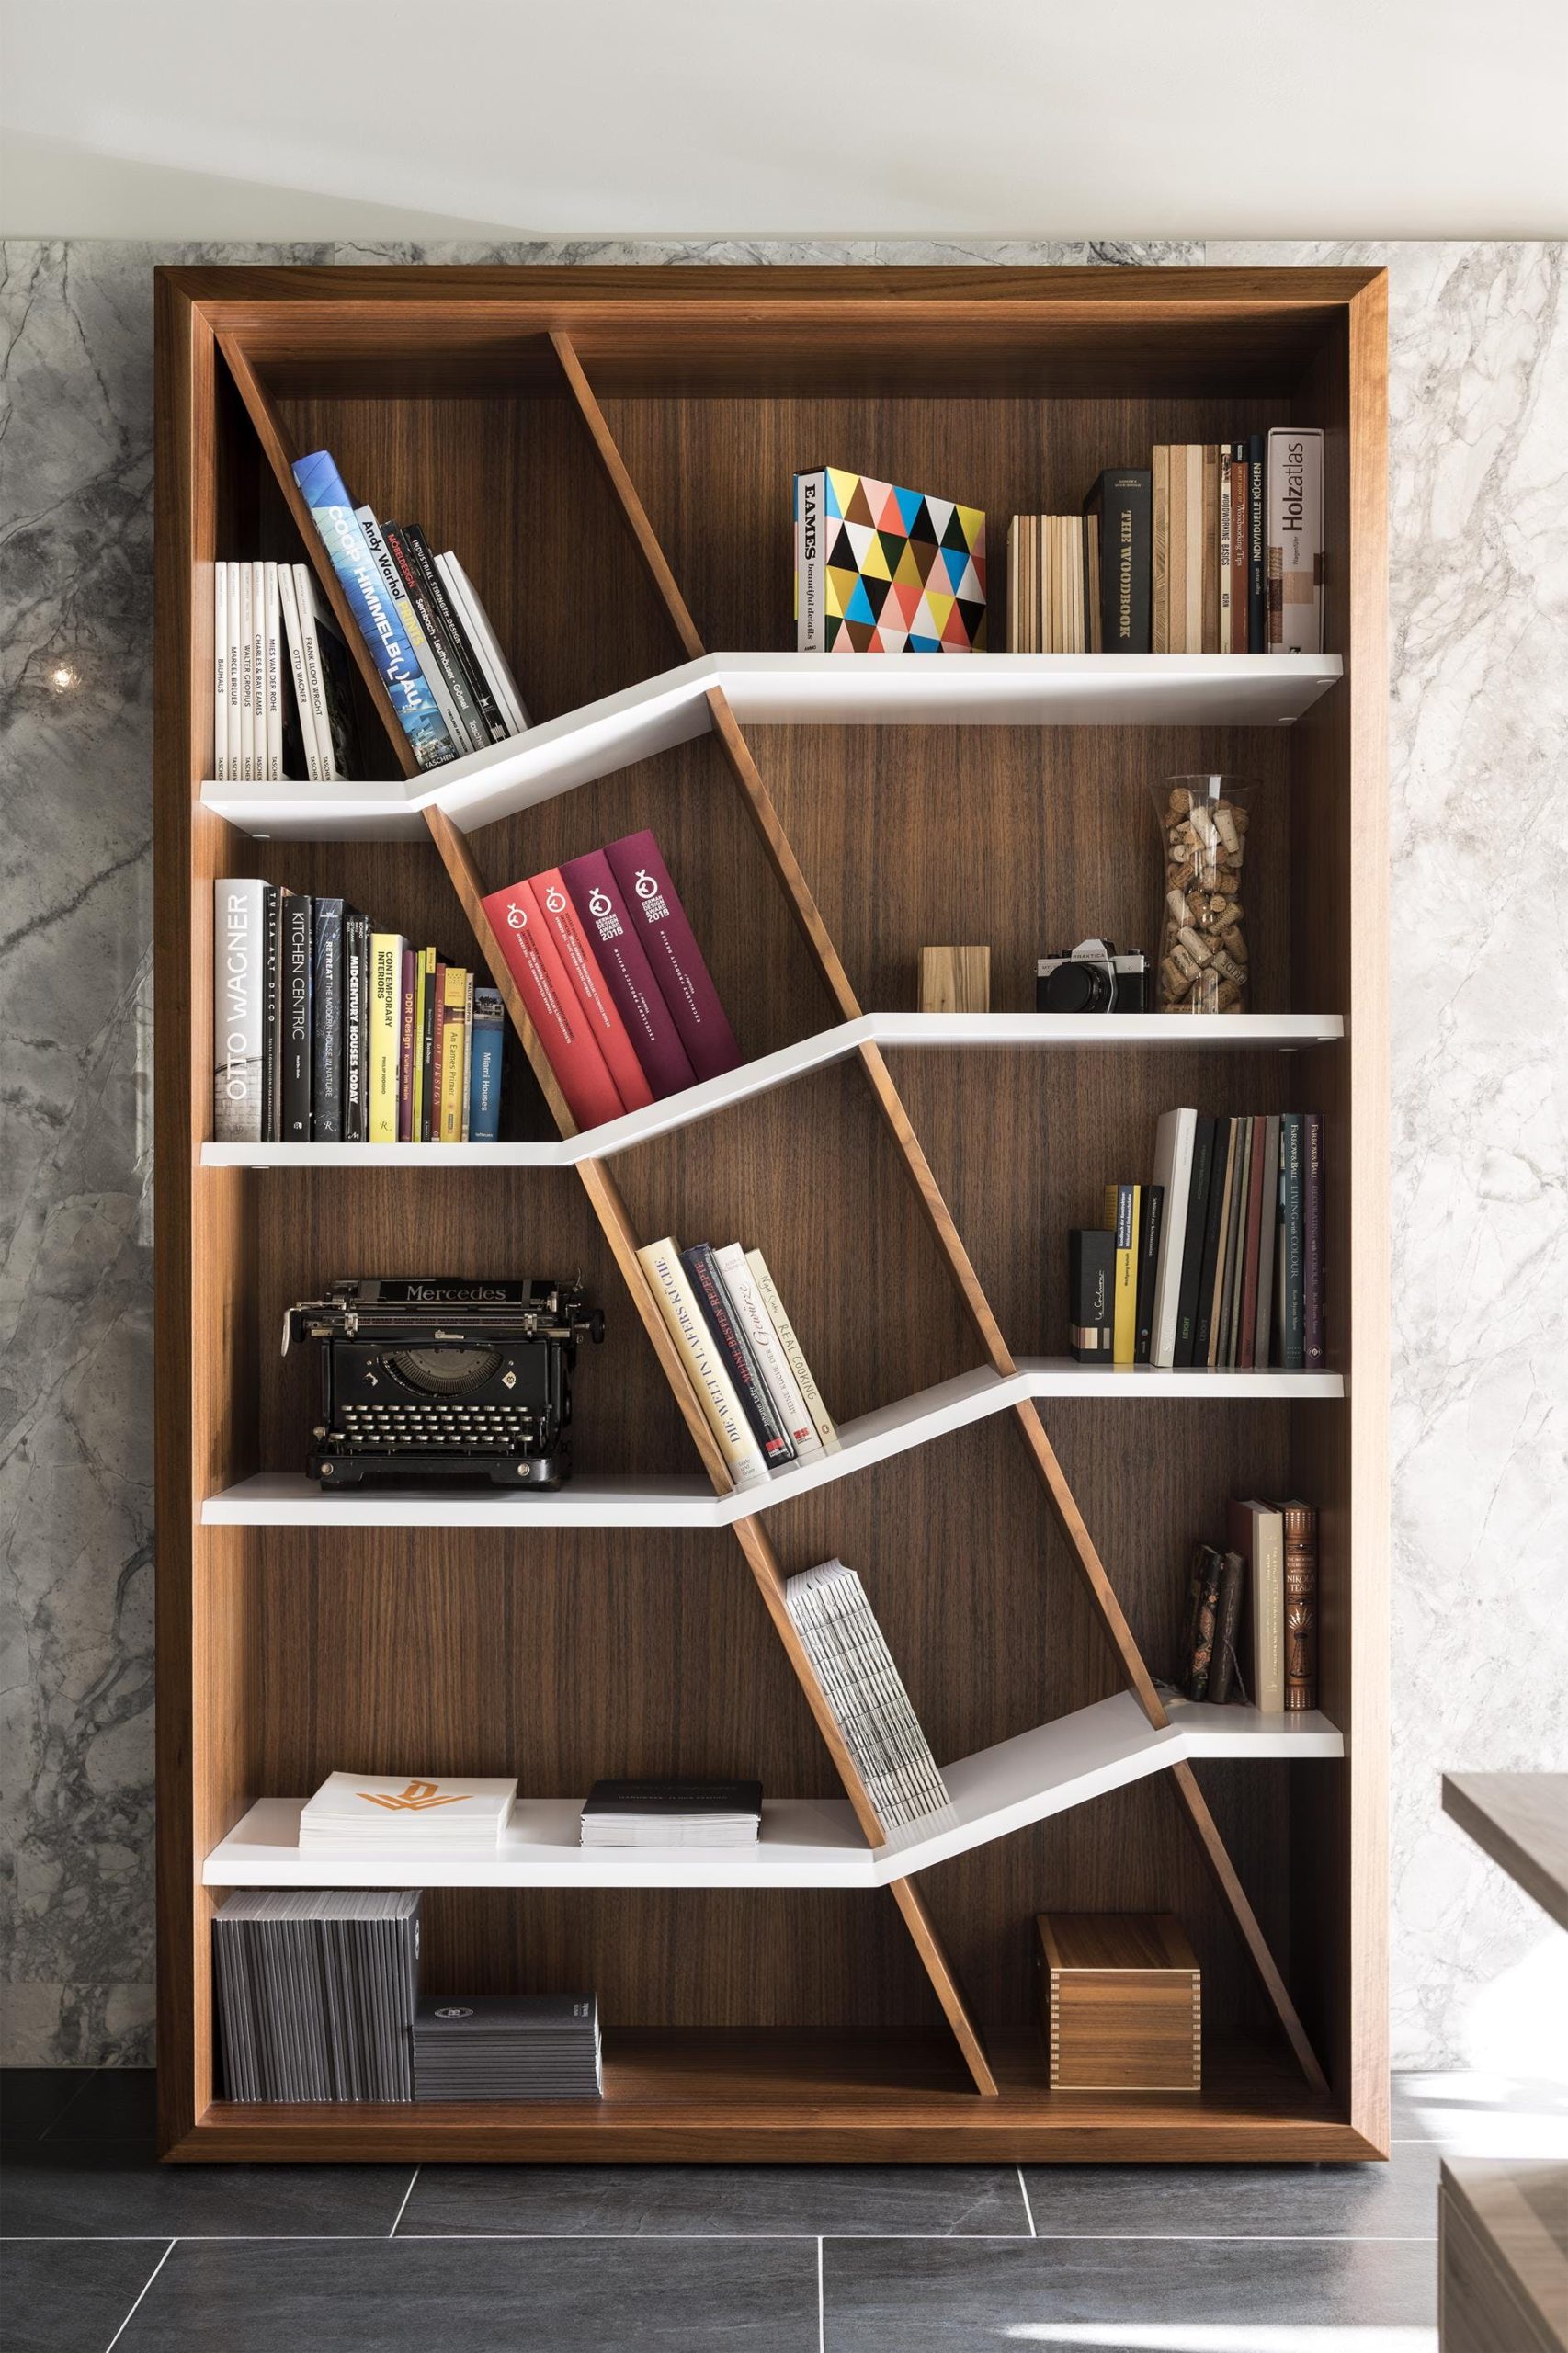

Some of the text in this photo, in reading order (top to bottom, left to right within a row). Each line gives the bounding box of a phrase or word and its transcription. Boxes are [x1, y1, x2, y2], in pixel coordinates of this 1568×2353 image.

[1252, 463, 1261, 499] KÜCHEN
[1283, 443, 1303, 531] Holzatlas
[329, 506, 361, 563] COOP
[805, 483, 816, 560] EAMES
[1235, 504, 1244, 550] Woodworking
[388, 533, 415, 588] MÖBELDESIGN
[1119, 510, 1131, 638] THE WOODBOOK
[1235, 551, 1244, 566] Tips
[362, 521, 425, 647] Andy Warhol PRINTS
[412, 539, 461, 644] INDUSTRIAL STRENGTH DESIGN
[415, 597, 435, 636] Sembach
[433, 640, 456, 681] Leuthäuser
[807, 607, 816, 640] details
[296, 672, 307, 703] WAGNER
[305, 637, 323, 716] FRANK LLOYD WRIGHT
[425, 752, 455, 768] TASCHEN
[596, 913, 616, 924] GERMAN
[642, 894, 662, 905] GERMAN
[643, 898, 664, 910] DESIGN
[645, 903, 665, 915] AWARD
[647, 908, 669, 922] 2018
[597, 916, 618, 928] DESIGN
[599, 921, 619, 933] AWARD
[601, 926, 623, 940] 2018
[267, 947, 276, 971] ART
[292, 913, 305, 1040] KITCHEN CENTRIC
[660, 930, 700, 1021] EXCELLENT PRODUCT DESIGN
[1221, 958, 1246, 983] PRIDE
[226, 894, 248, 1100] OTTO WAGNER
[384, 952, 393, 1028] CONTEMPORARY
[404, 993, 413, 1014] DDR
[614, 949, 654, 1040] EXCELLENT PRODUCT DESIGN
[349, 956, 358, 1104] MIDCENTURY HOUSES TODAY
[403, 1016, 412, 1049] Design
[325, 1058, 333, 1066] IN
[403, 1074, 409, 1083] im
[448, 1032, 458, 1096] An Eames Primer
[479, 1051, 491, 1110] Miami Houses
[433, 1063, 441, 1105] DESIGN
[1290, 1124, 1298, 1179] FARROW&BALL
[1310, 1124, 1318, 1179] FARROW&BALL
[406, 1285, 506, 1302] Mercedes
[695, 1261, 751, 1383] MEINE BESTEN REZEPTE
[734, 1283, 771, 1347] Gewürze
[653, 1257, 740, 1442] DIE WELT IN LAFERS KÜCHE
[766, 1348, 775, 1362] DER
[778, 1324, 816, 1400] REAL COOKING
[771, 1365, 786, 1390] KÜCHE
[749, 1386, 769, 1427] Johann Lafer
[783, 1391, 795, 1414] MEINE
[1290, 1584, 1314, 1592] TESLA
